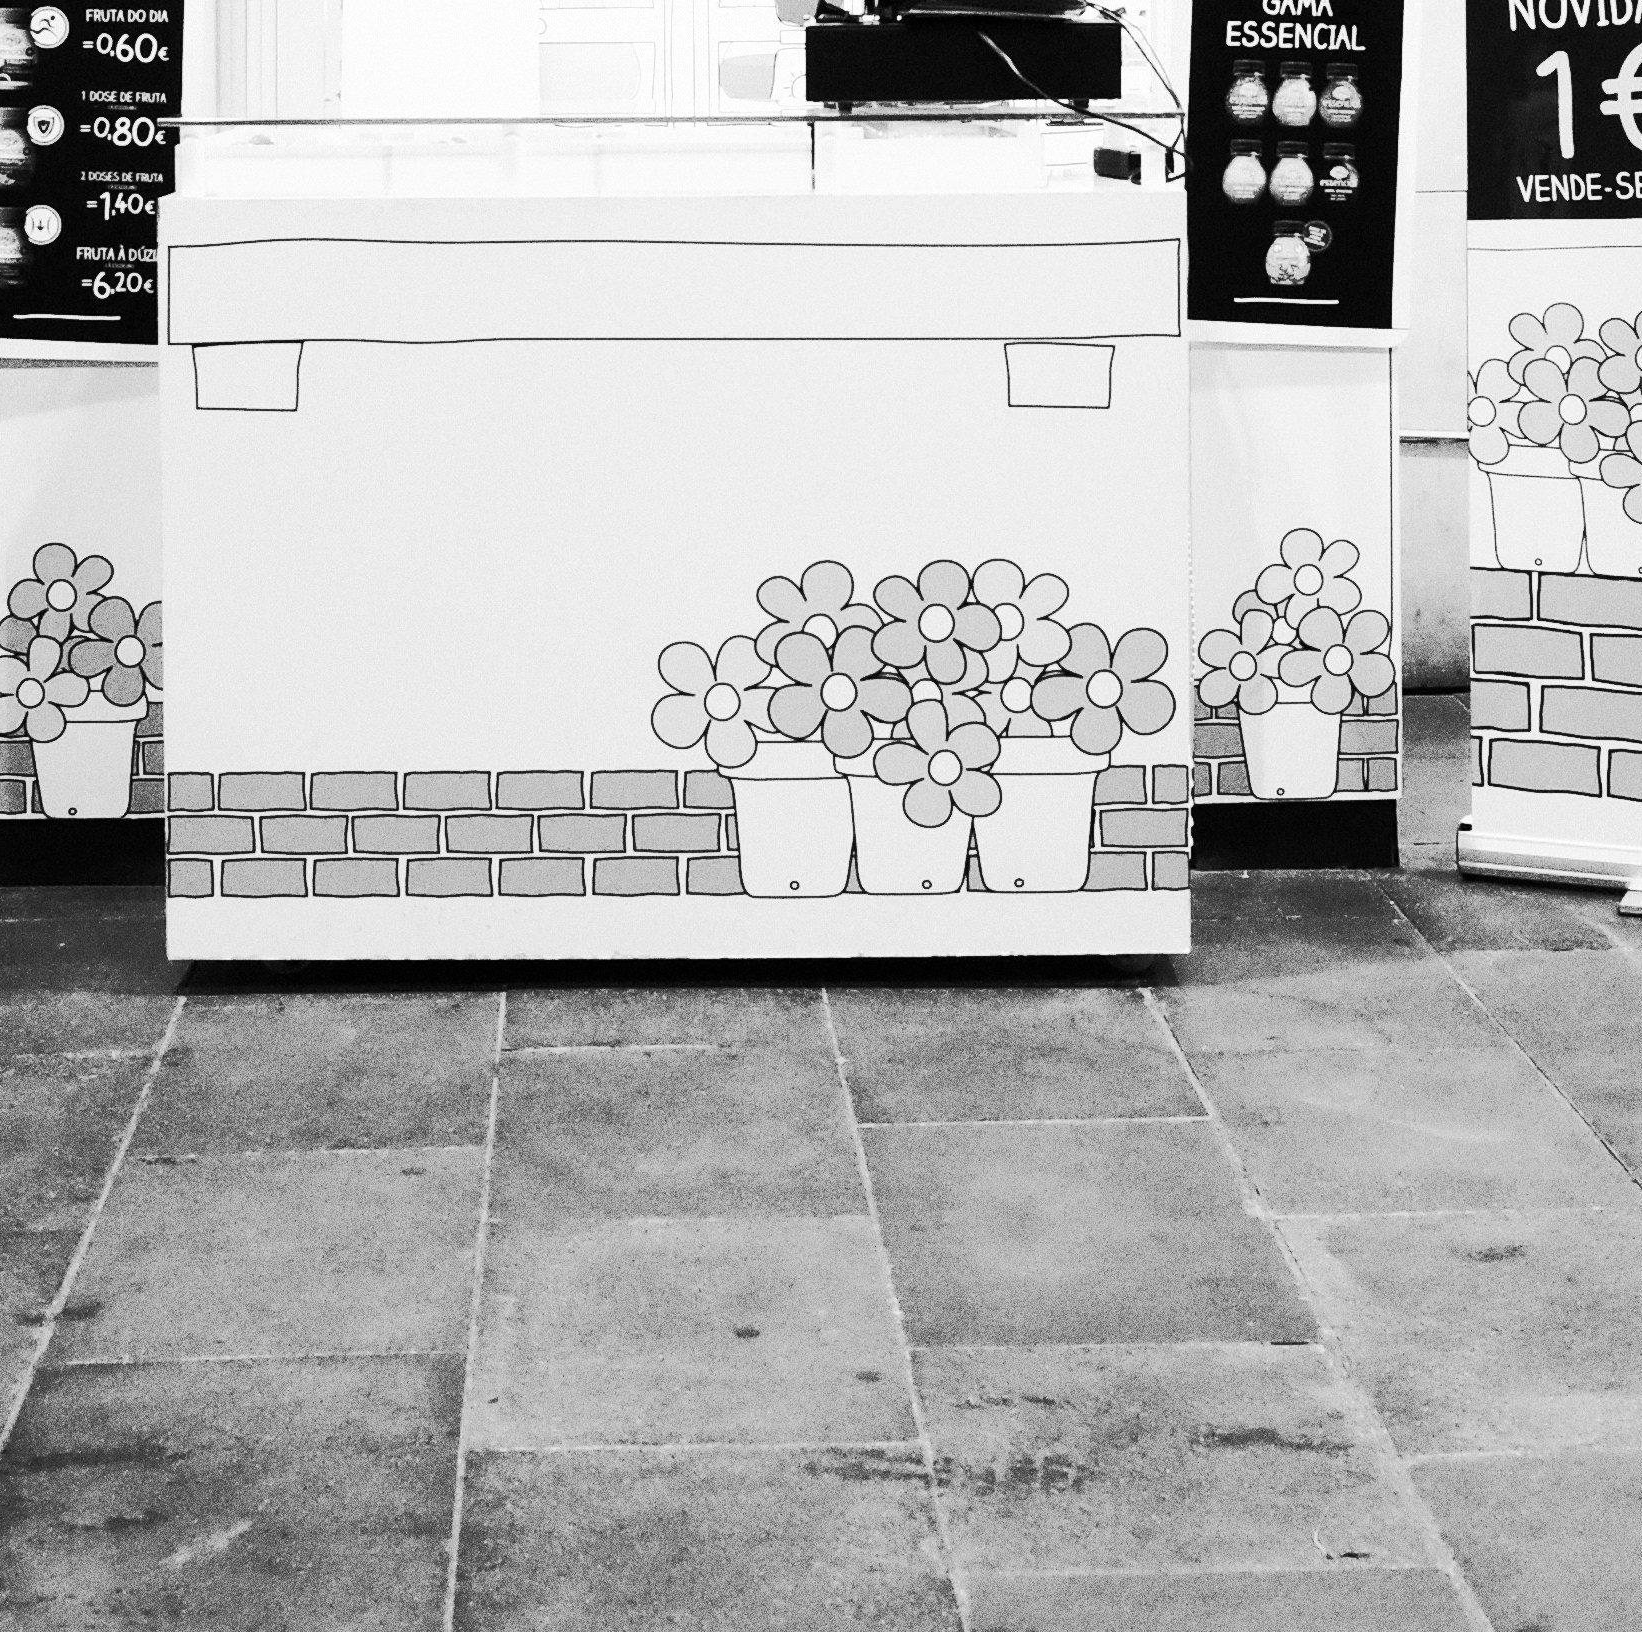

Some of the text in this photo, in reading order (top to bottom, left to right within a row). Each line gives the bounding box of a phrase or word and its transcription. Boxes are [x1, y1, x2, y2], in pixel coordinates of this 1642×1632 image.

[86, 8, 169, 23] FRUTA DO DIA
[1226, 20, 1366, 51] ESSENCIAL
[89, 91, 117, 103] DOSE
[119, 91, 134, 103] DE
[136, 92, 167, 104] FRUTA
[88, 171, 120, 182] DOSES
[121, 172, 134, 183] DE
[136, 172, 164, 184] FRUTA
[76, 245, 158, 262] FRUTA À DÚZI
